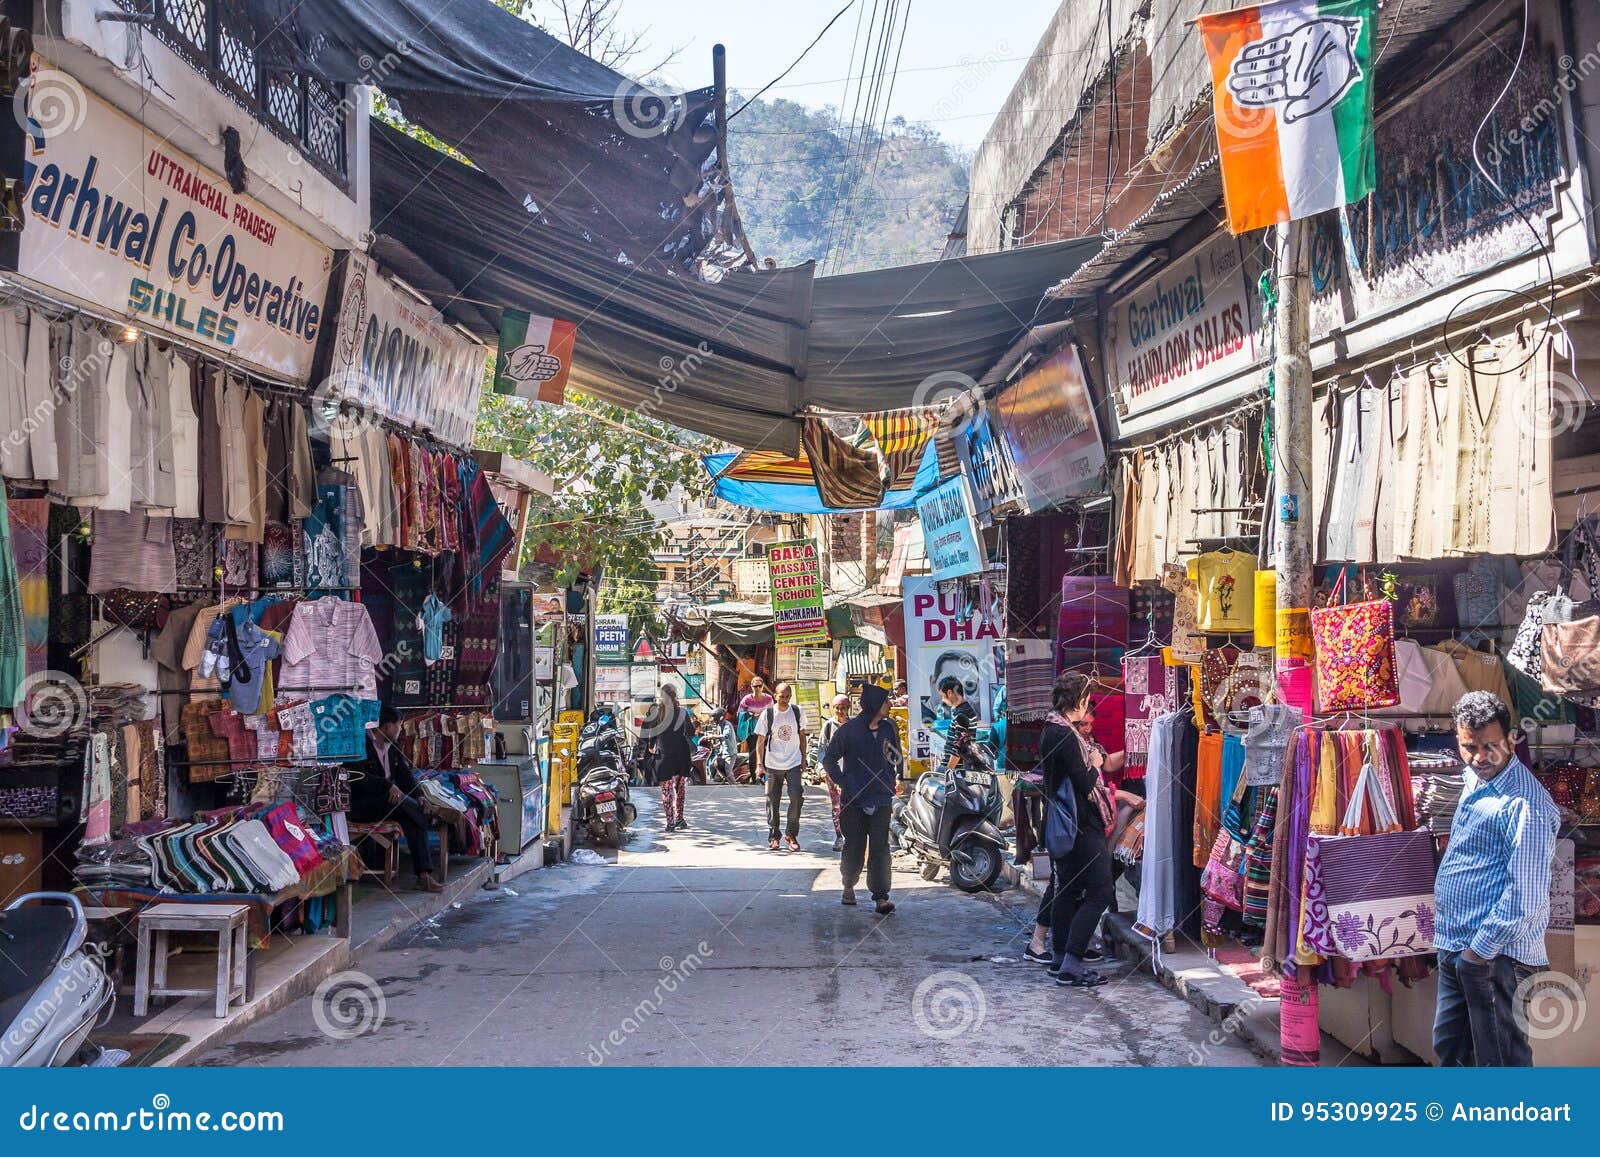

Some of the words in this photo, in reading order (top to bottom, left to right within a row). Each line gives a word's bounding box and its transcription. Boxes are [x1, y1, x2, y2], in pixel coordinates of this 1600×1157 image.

[148, 150, 229, 220] UTTRANCHAL
[233, 202, 277, 247] PRADESH
[1128, 255, 1206, 348] Garhwal
[128, 277, 239, 346] SALES
[1128, 329, 1193, 399] HANDLOOM
[1193, 303, 1245, 371] SALES
[770, 545, 814, 562] BABA
[770, 561, 817, 576] MASSAGE
[773, 574, 817, 589] CENTRE
[776, 588, 817, 601] SCHOOL
[775, 606, 822, 622] PANCHKARMA
[599, 631, 626, 641] PEETH
[924, 619, 1004, 642] DHA
